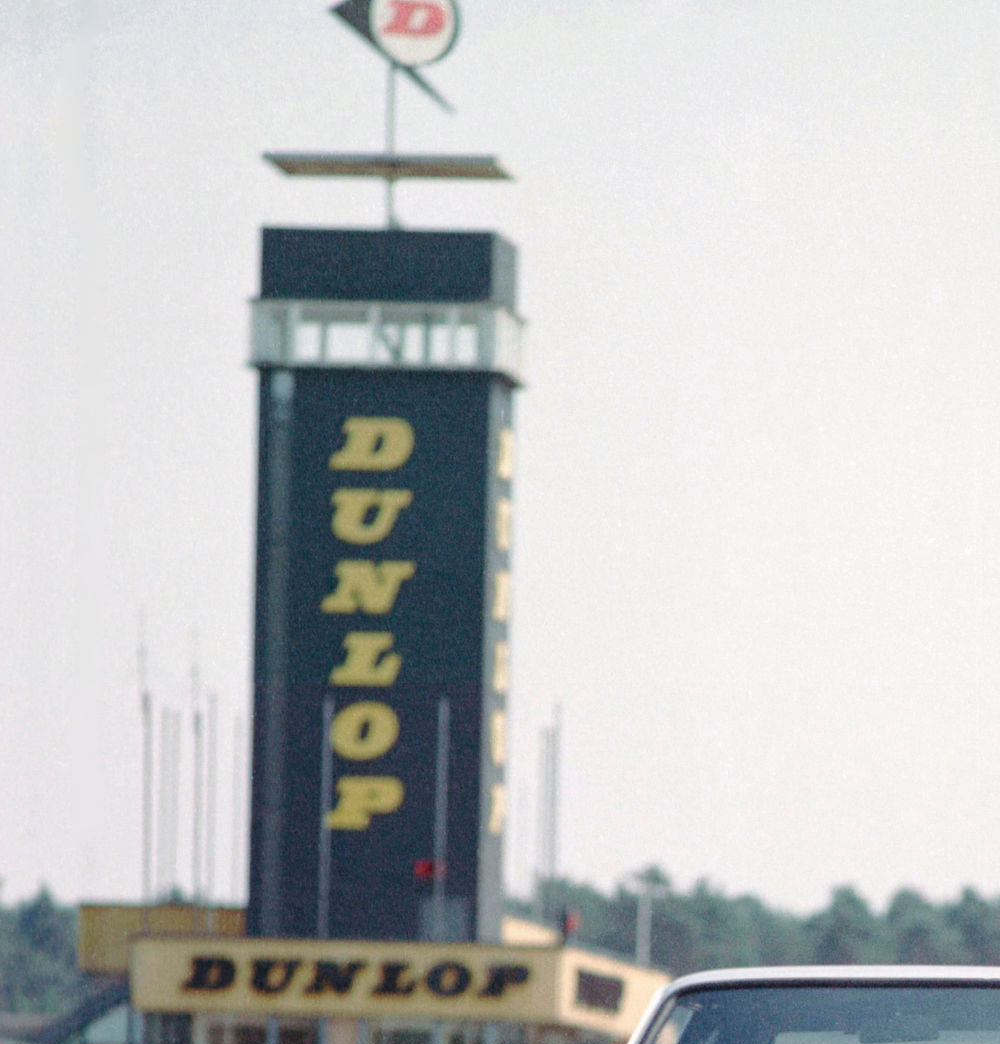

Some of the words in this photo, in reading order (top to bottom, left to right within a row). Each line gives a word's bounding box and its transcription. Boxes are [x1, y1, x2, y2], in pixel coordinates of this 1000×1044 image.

[382, 0, 446, 36] D
[321, 417, 417, 829] DUNLOP
[183, 957, 530, 997] DUNLOP
